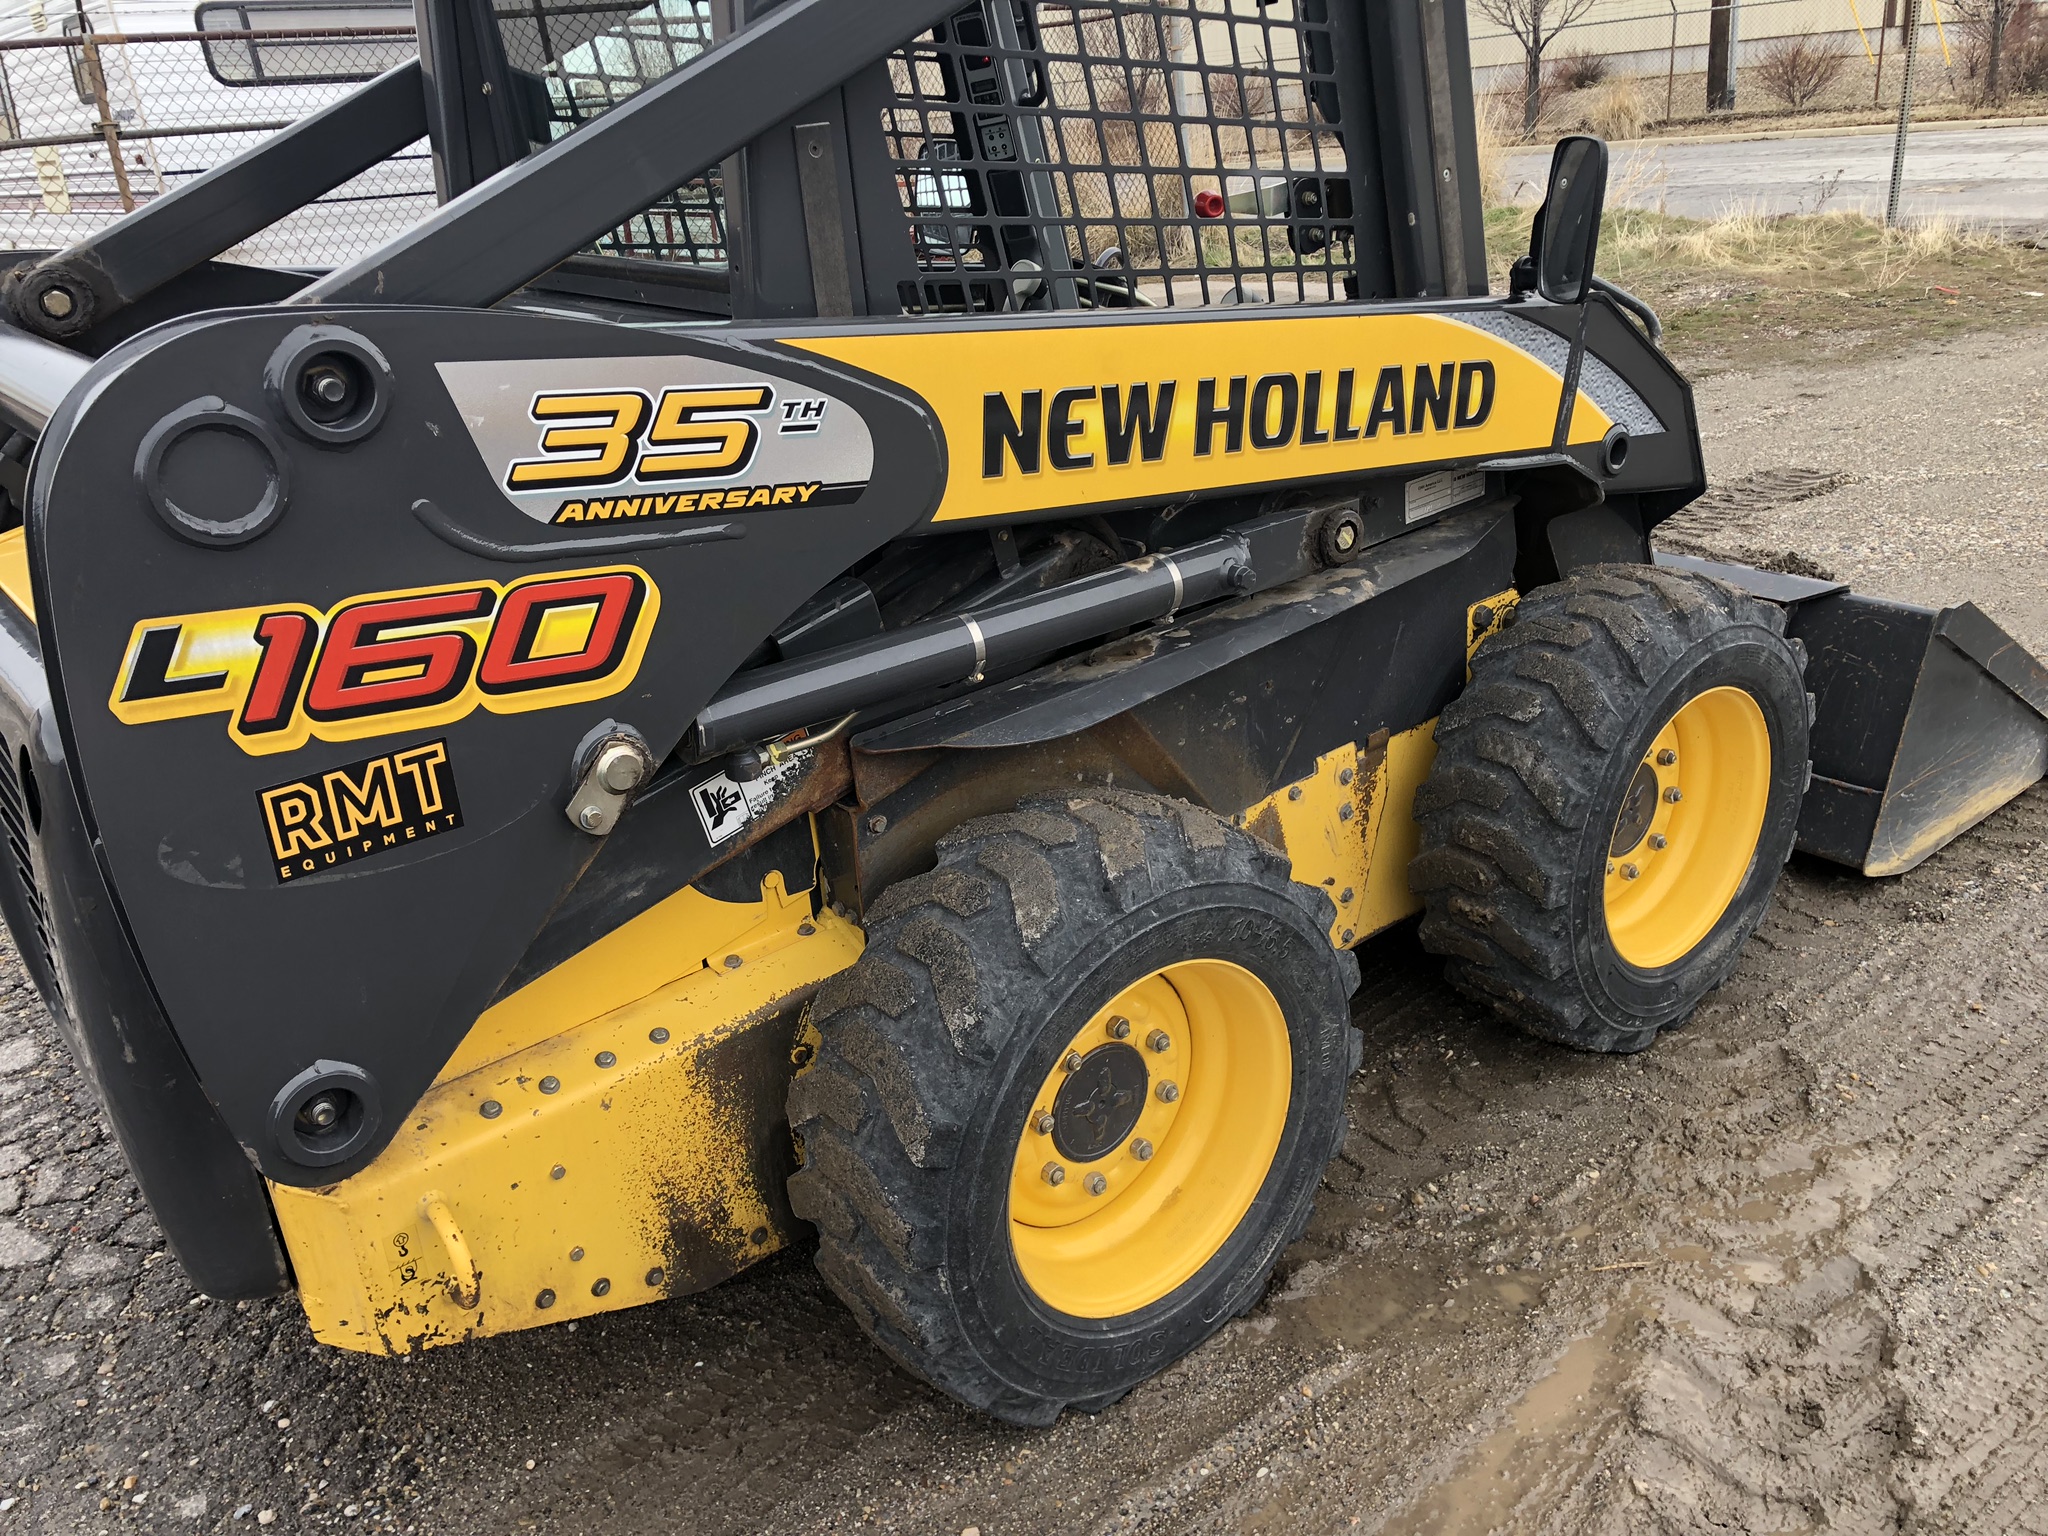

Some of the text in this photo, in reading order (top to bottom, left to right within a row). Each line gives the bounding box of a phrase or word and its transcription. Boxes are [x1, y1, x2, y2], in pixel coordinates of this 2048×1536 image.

[504, 383, 826, 494] 35 TH
[982, 359, 1496, 478] NEW HOLLAND
[555, 484, 820, 523] ANNIVERSARY
[118, 571, 648, 737] L160
[262, 741, 446, 860] RMT
[280, 813, 455, 879] EQUIPMENT
